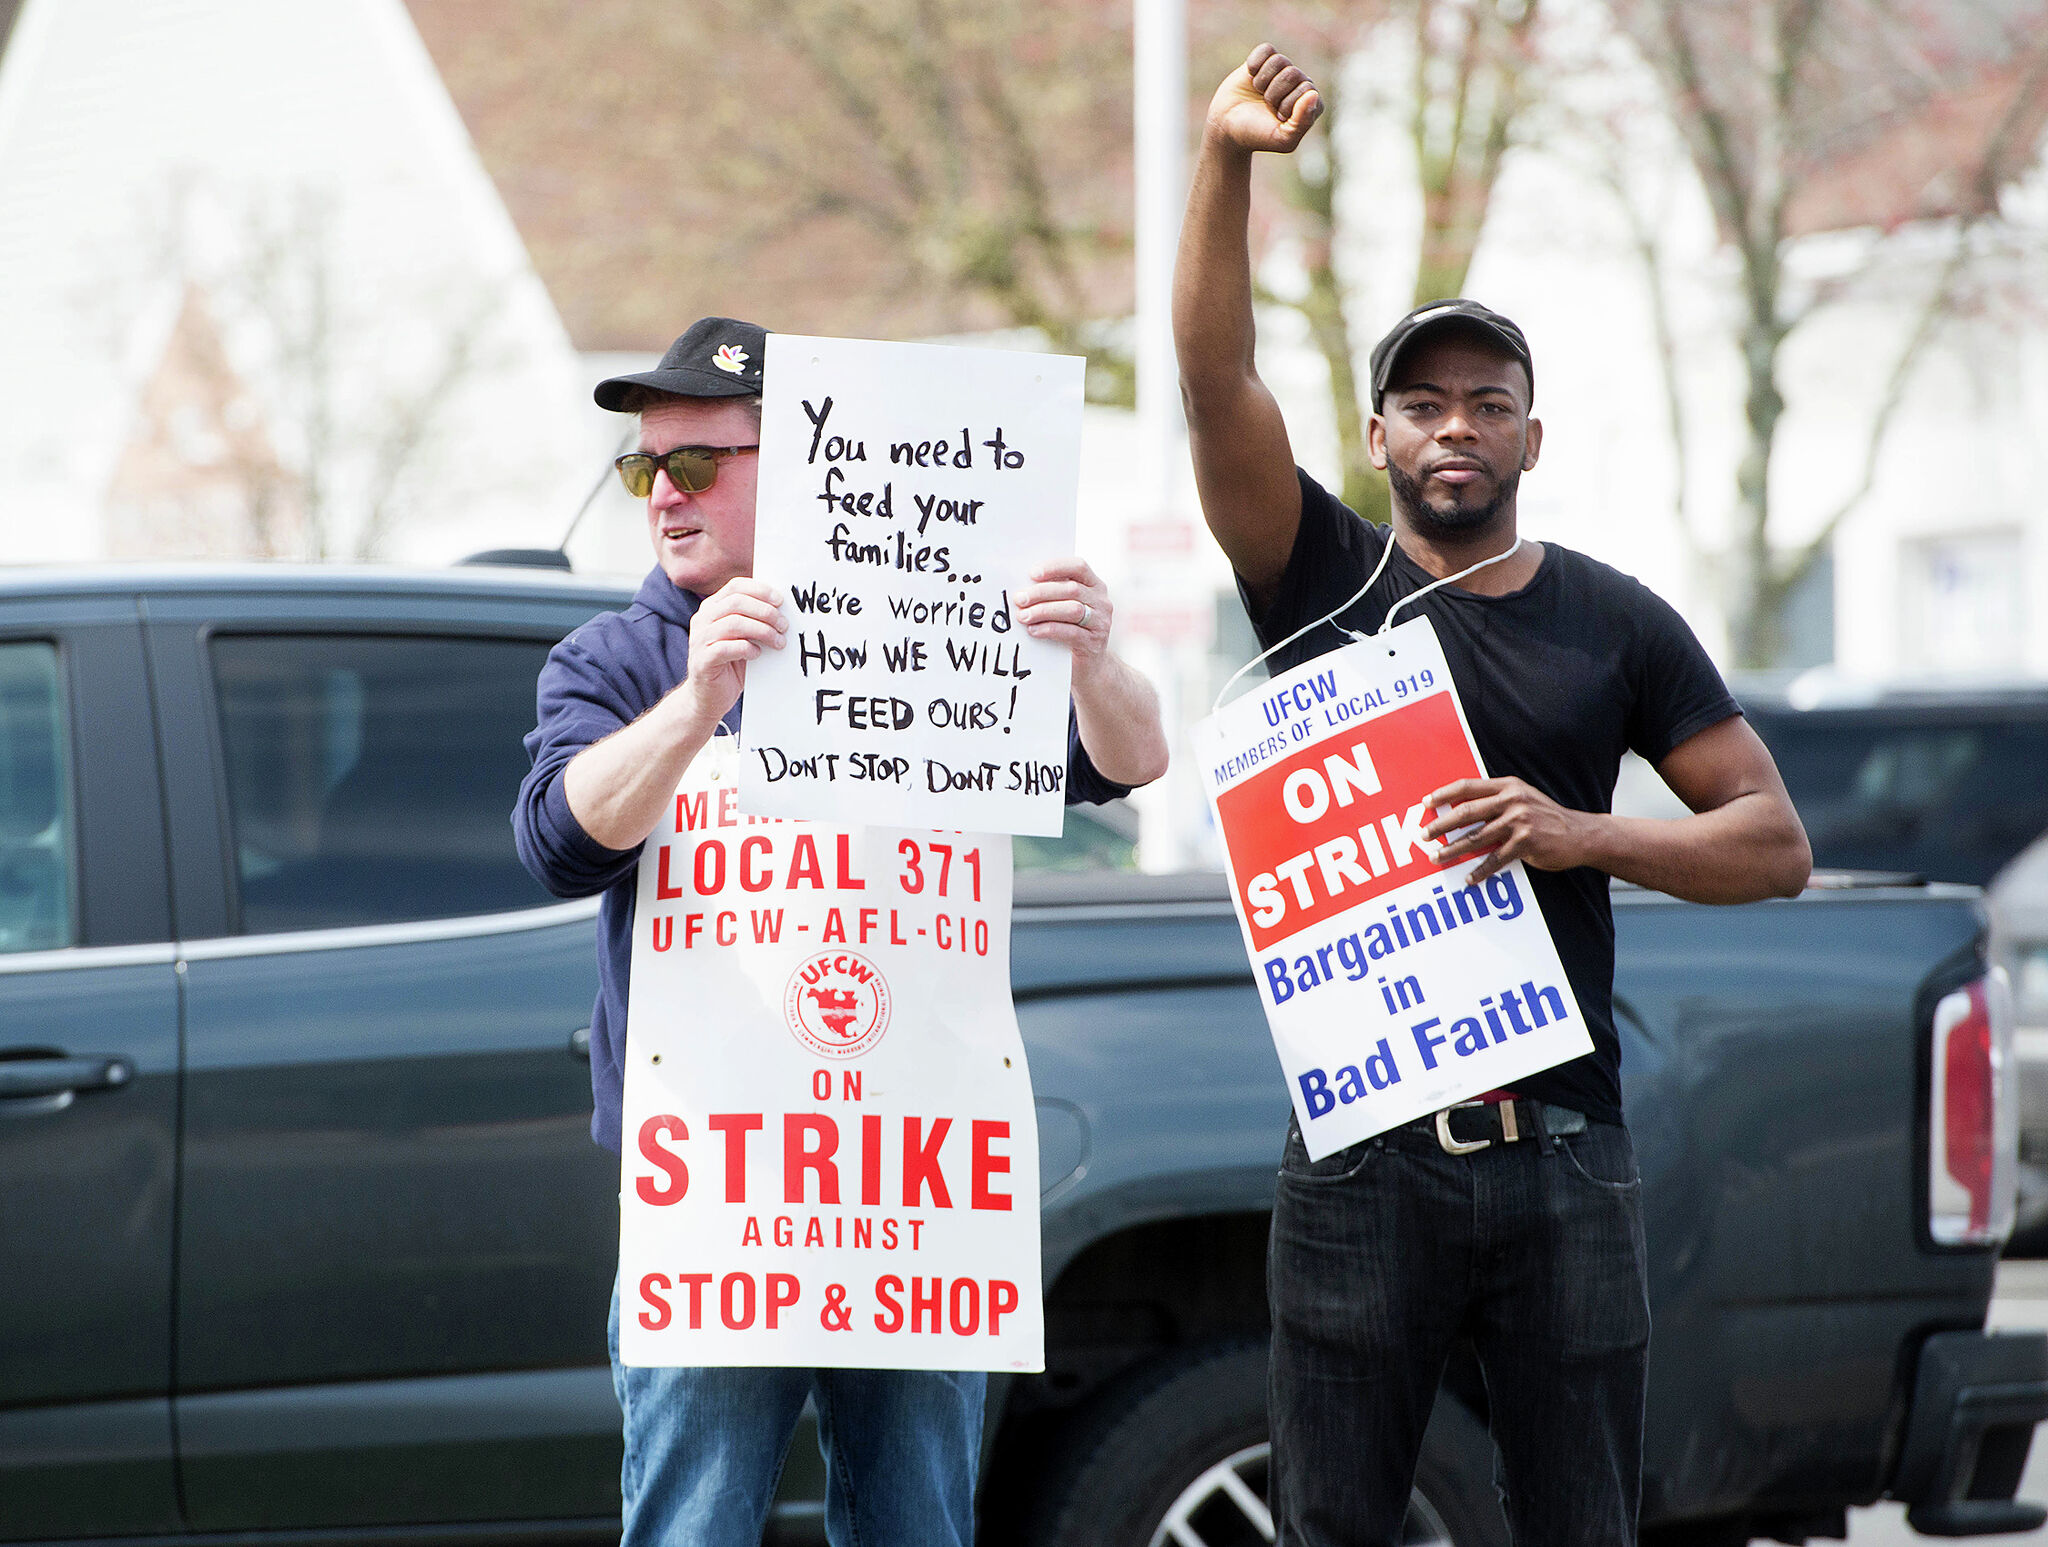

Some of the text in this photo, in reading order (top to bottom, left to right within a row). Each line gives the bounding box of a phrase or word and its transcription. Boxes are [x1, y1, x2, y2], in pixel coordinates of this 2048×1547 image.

[802, 396, 1025, 470] You need to
[817, 467, 985, 534] feed your
[791, 581, 1011, 633] We're worried
[883, 637, 928, 672] WE
[946, 637, 1031, 680] WILL
[815, 685, 1017, 734] FEED OURS!
[1213, 669, 1435, 785] MEMBERS OF LOCAL 919
[1262, 669, 1338, 727] UFCW
[1005, 761, 1064, 795] SHOP
[1283, 742, 1383, 824] ON
[656, 833, 981, 902] LOCAL 371
[1264, 870, 1524, 1006] Bargaining
[799, 955, 875, 985] UFCW
[1377, 975, 1426, 1015] in
[1298, 981, 1568, 1120] Bad Faith
[812, 1069, 862, 1101] ON
[635, 1113, 1013, 1211] STRIKE
[741, 1216, 925, 1251] AGAINST
[637, 1272, 1019, 1336] STOP & SHOP
